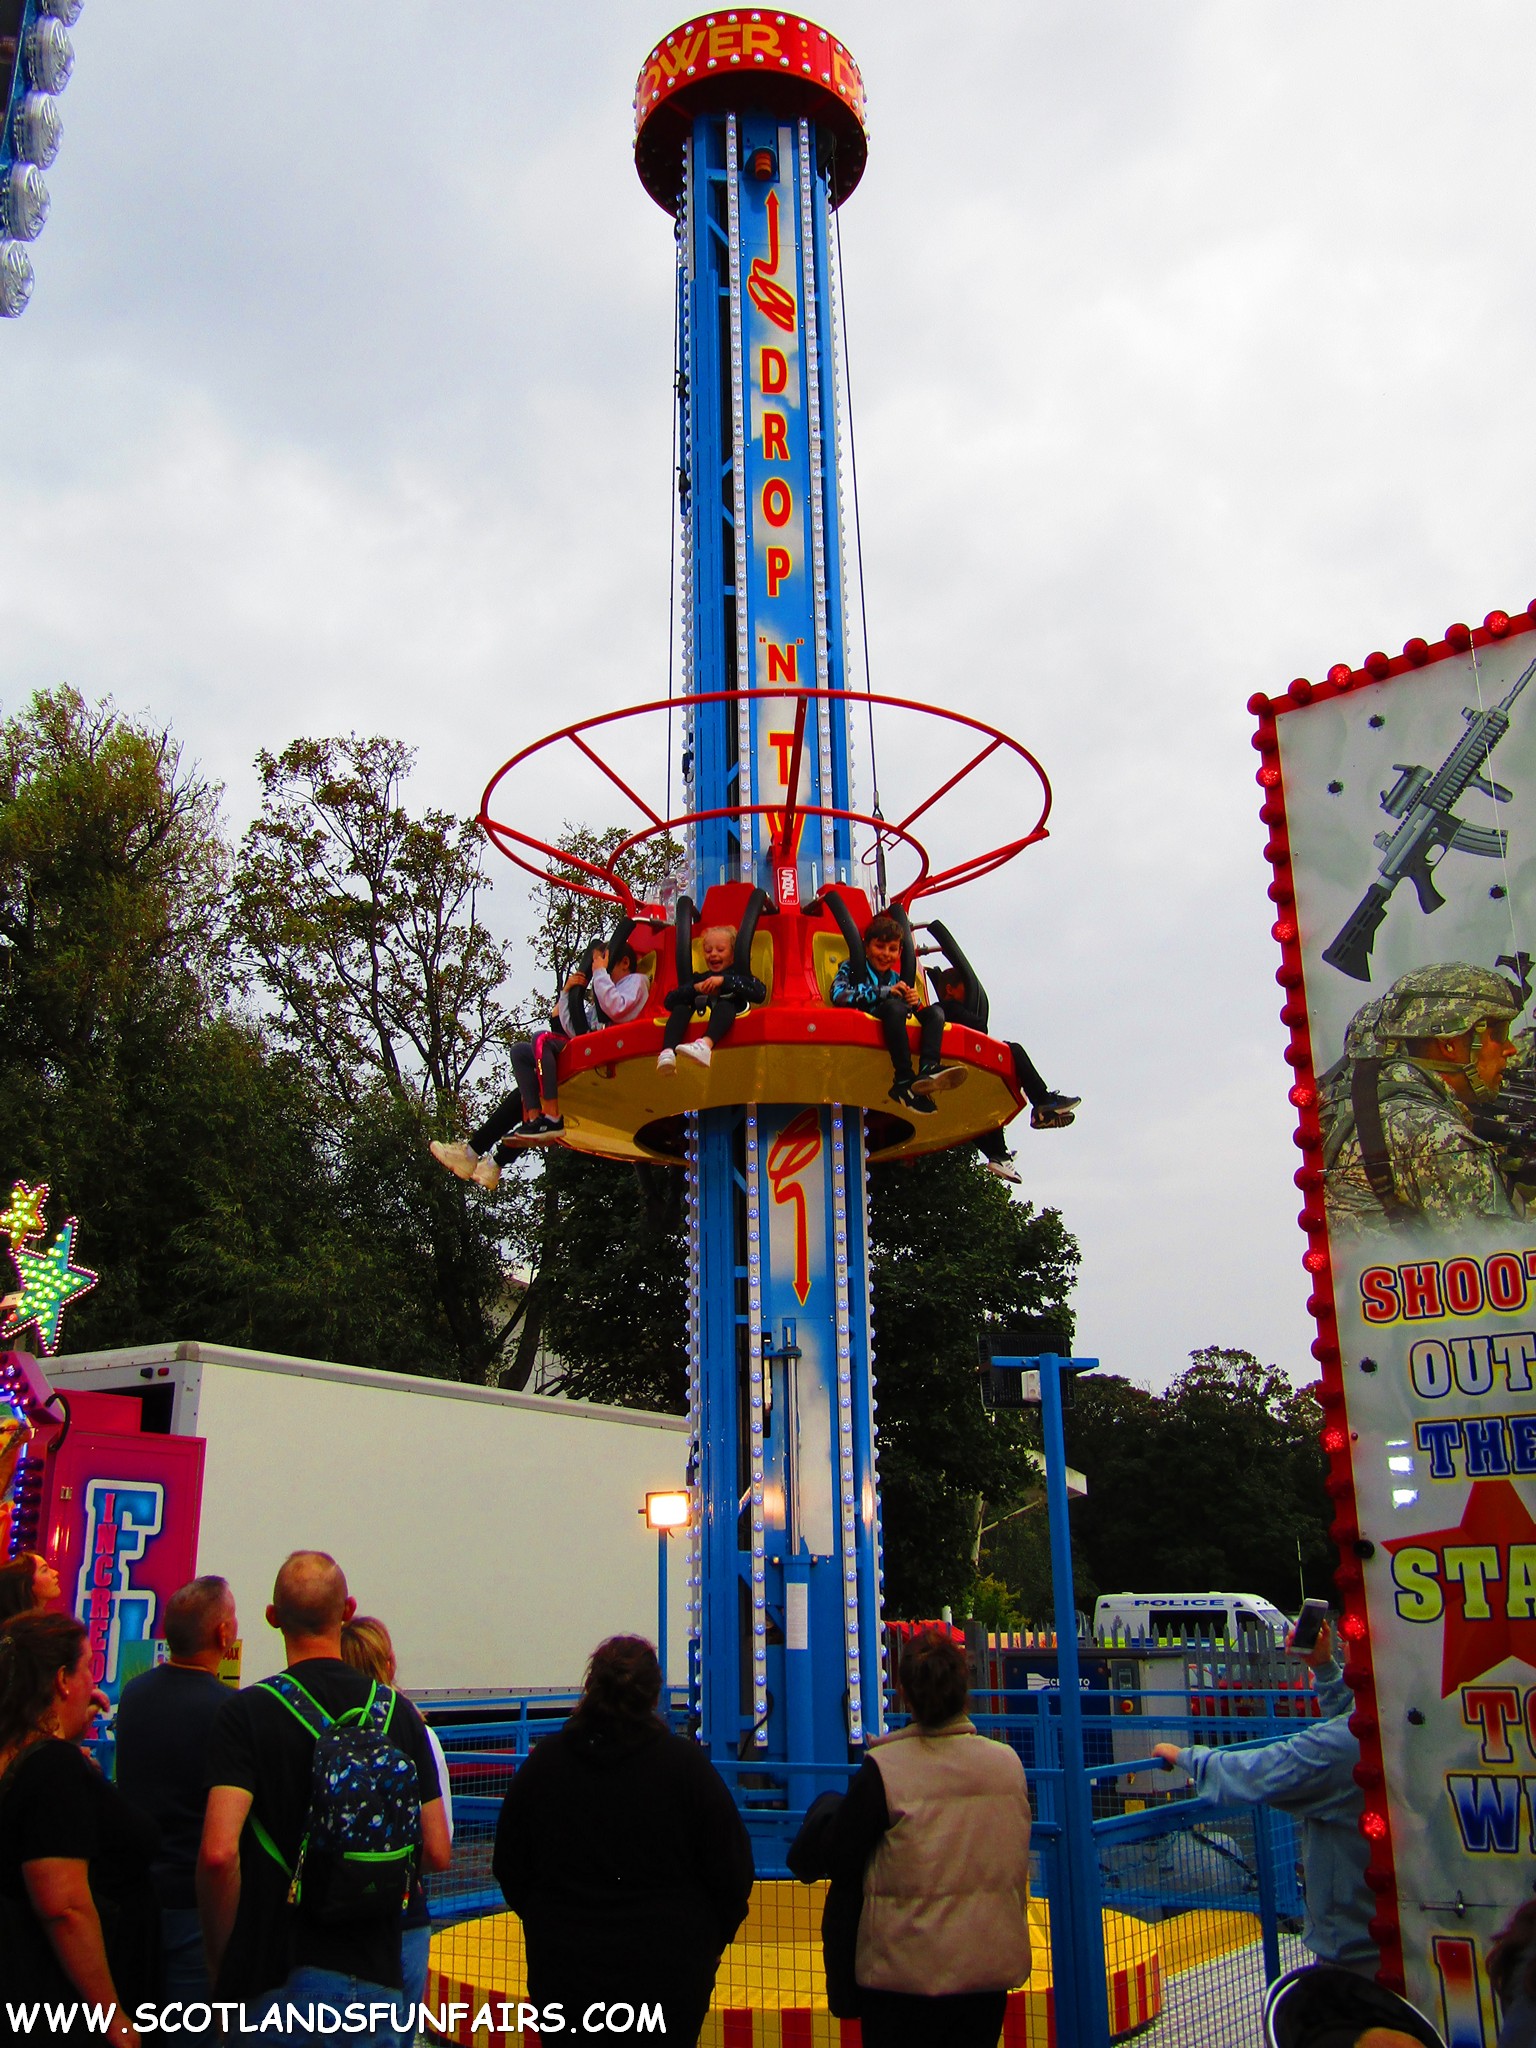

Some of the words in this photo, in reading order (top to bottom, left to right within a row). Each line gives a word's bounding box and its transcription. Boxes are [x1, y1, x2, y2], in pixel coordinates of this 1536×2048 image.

[760, 346, 793, 597] DROP
[781, 869, 795, 899] SBF
[1410, 1332, 1536, 1399] OUT
[1415, 1416, 1536, 1478] THE
[1133, 1599, 1225, 1607] POLICE
